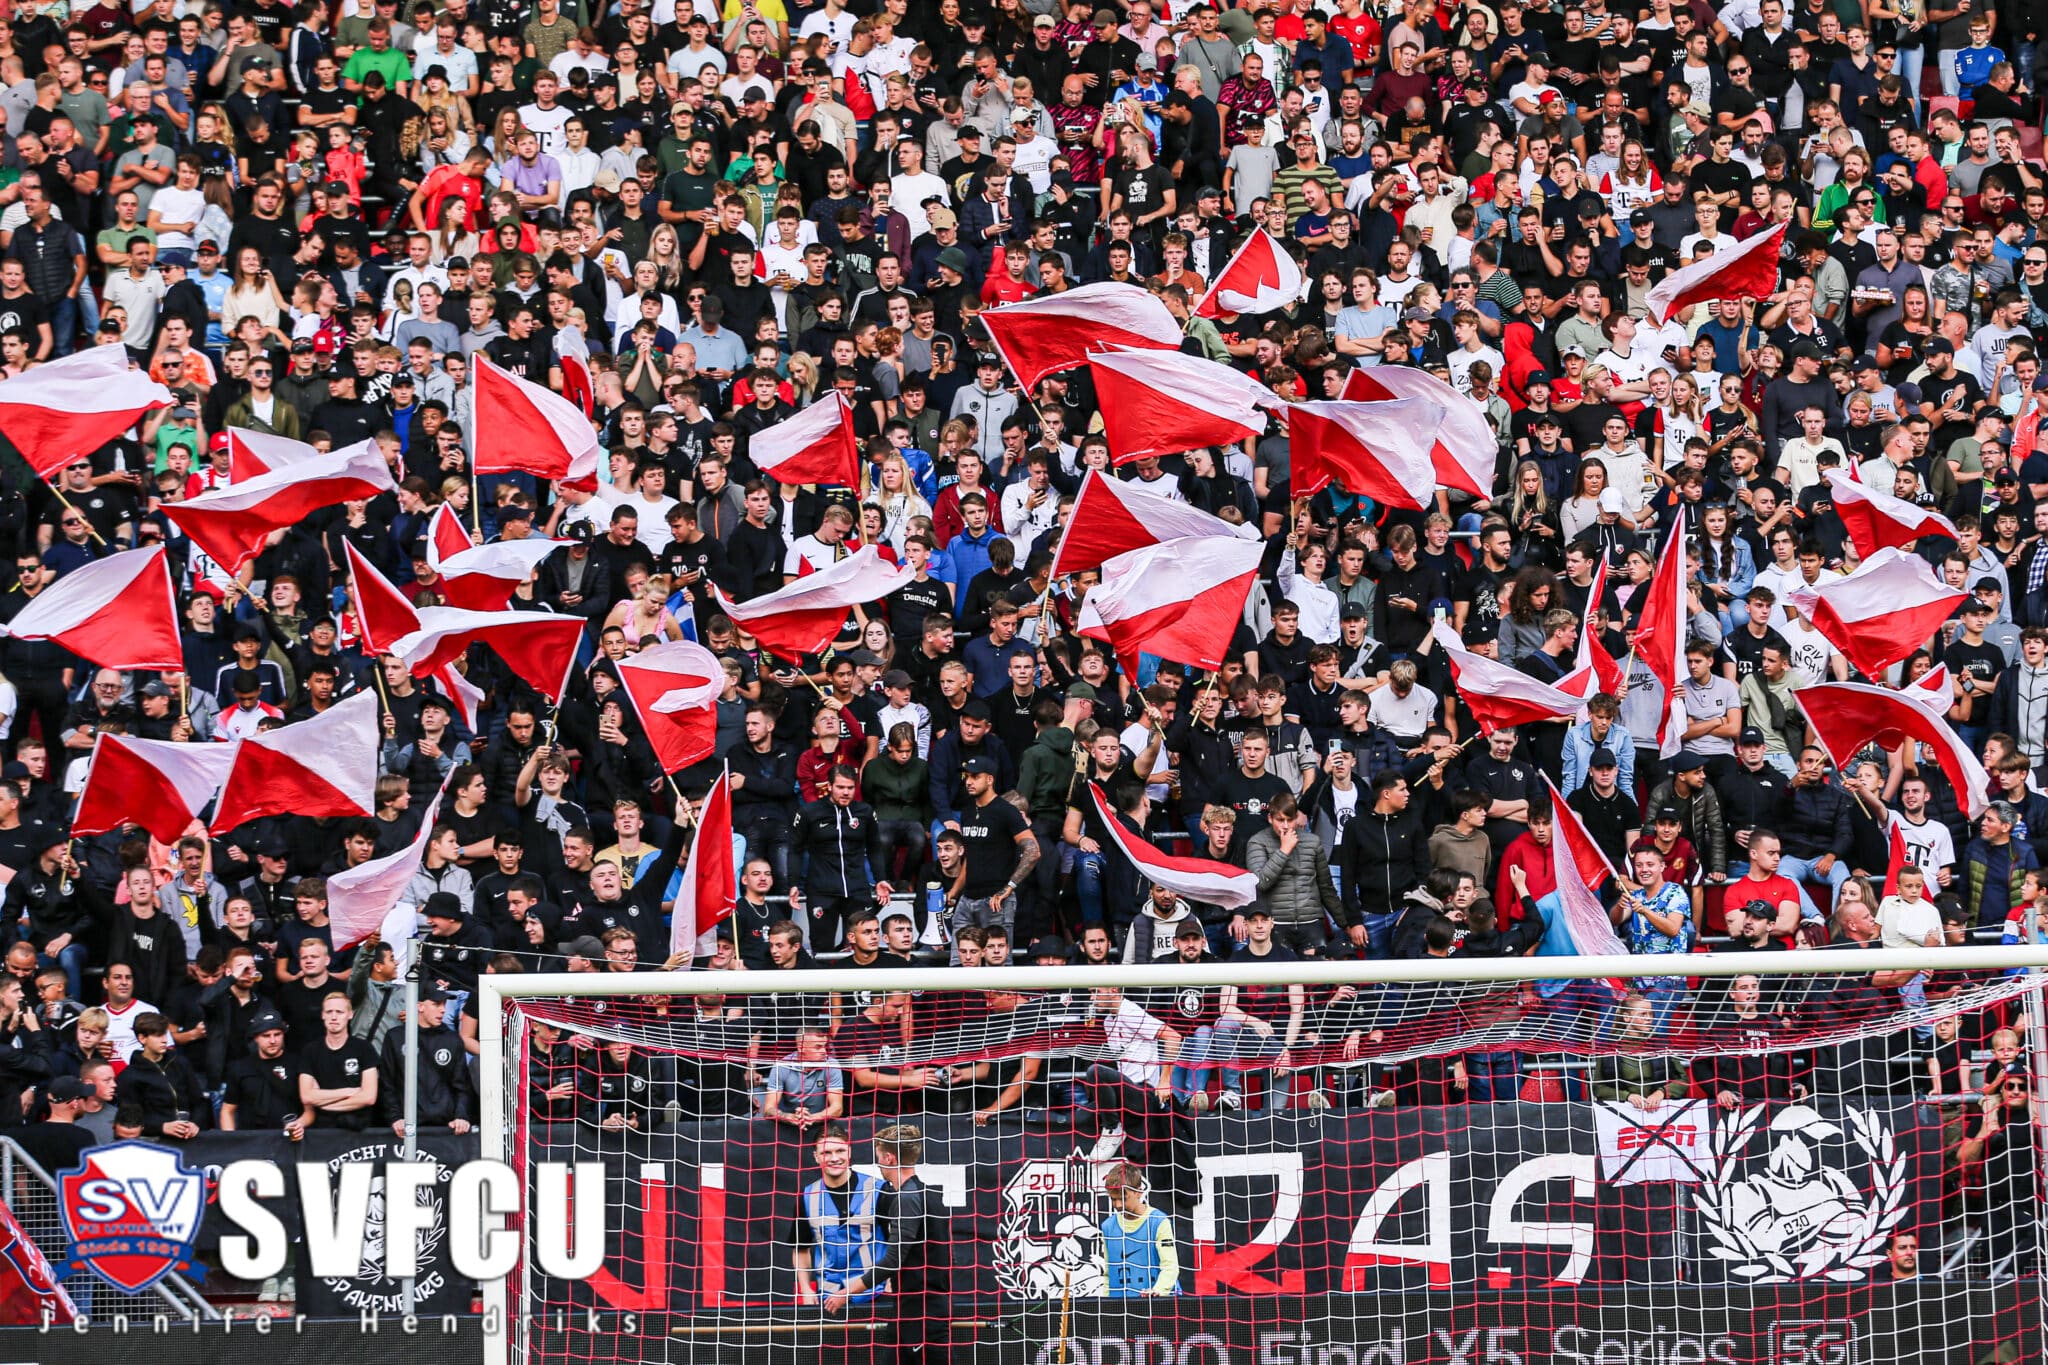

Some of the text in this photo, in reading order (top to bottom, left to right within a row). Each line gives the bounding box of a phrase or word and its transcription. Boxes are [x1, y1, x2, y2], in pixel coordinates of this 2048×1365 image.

[1647, 256, 1665, 267] echt
[1629, 673, 1651, 683] NIKE
[1617, 1125, 1697, 1150] ESPN
